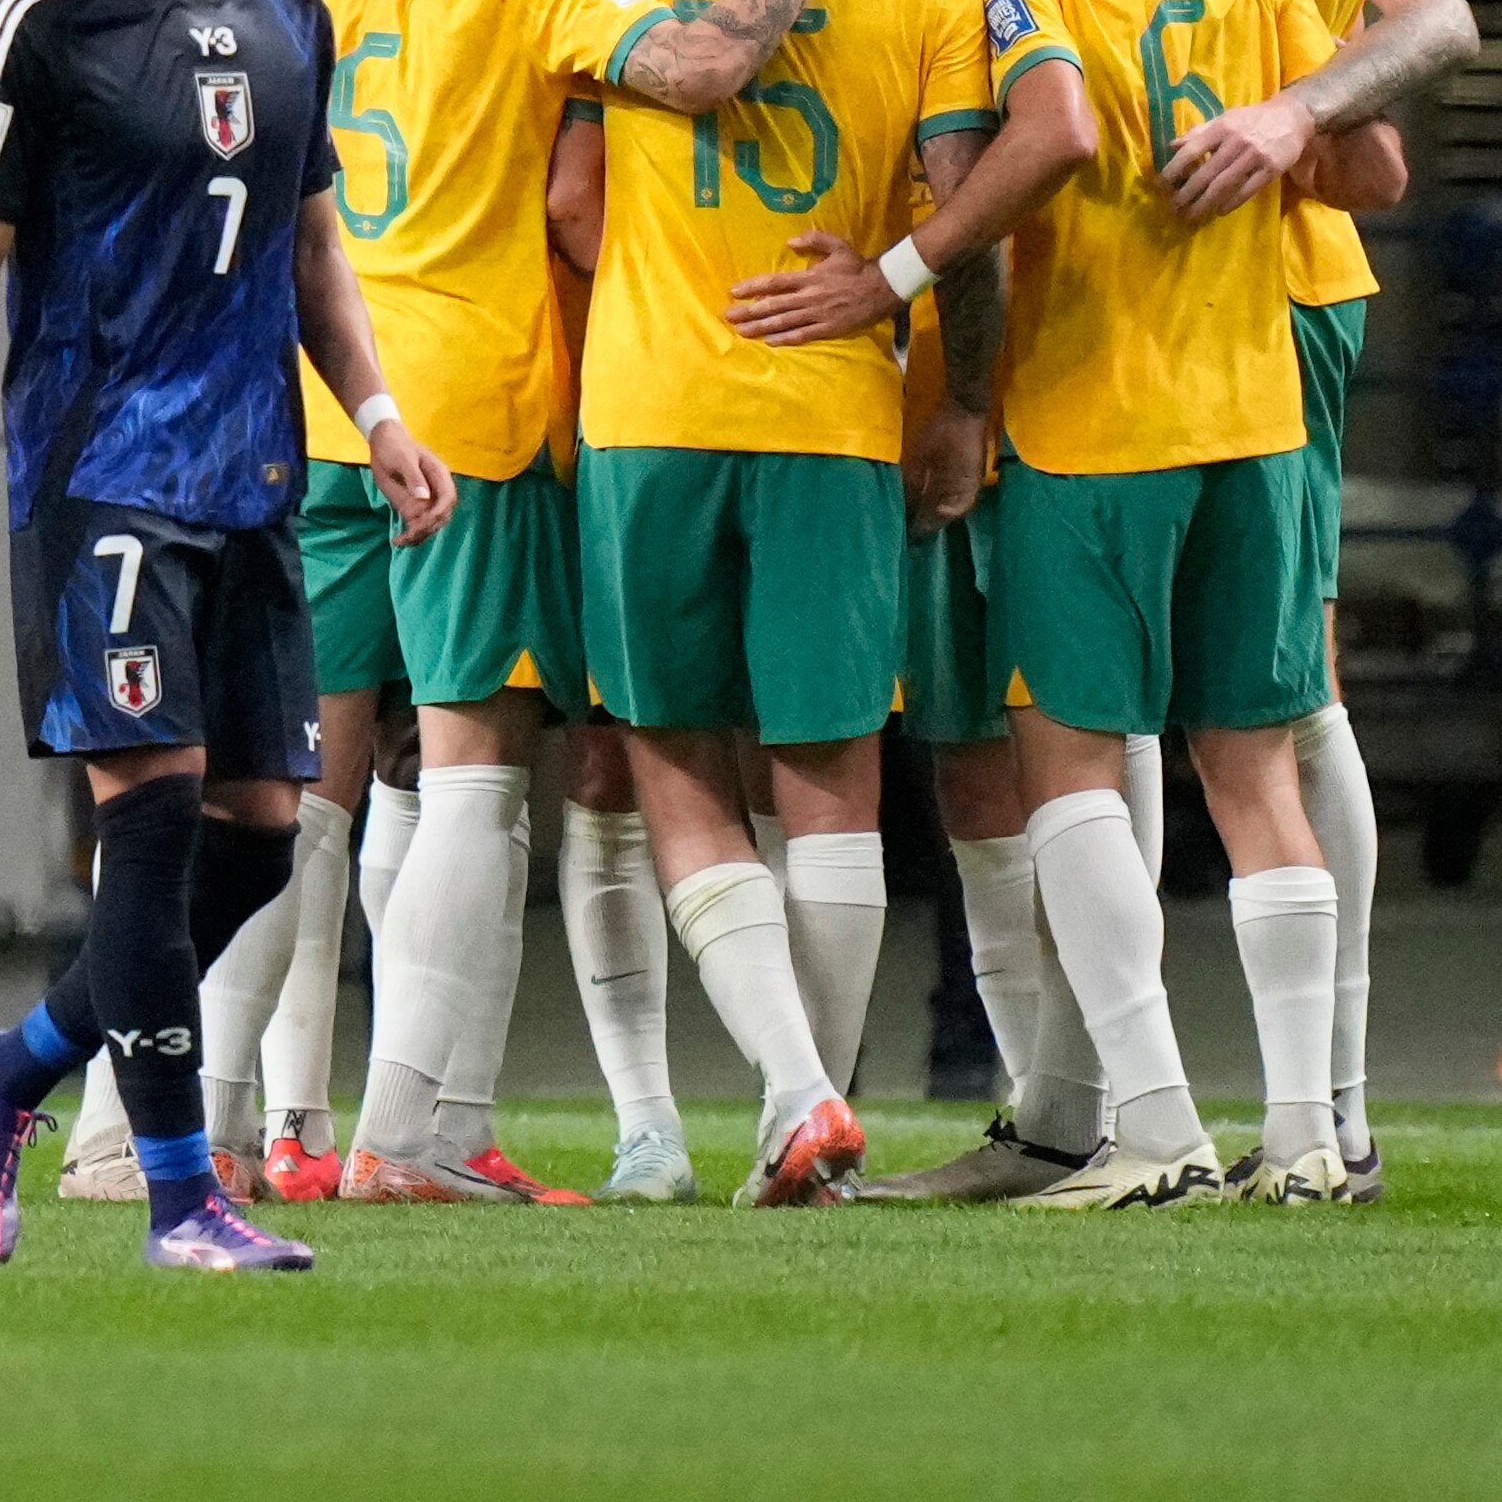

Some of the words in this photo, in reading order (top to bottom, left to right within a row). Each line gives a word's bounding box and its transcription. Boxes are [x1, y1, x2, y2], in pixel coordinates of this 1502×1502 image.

[189, 26, 238, 57] Y-3
[327, 31, 409, 240] 5
[207, 176, 248, 275] 7
[93, 533, 144, 635] 7
[106, 1027, 192, 1058] Y-3
